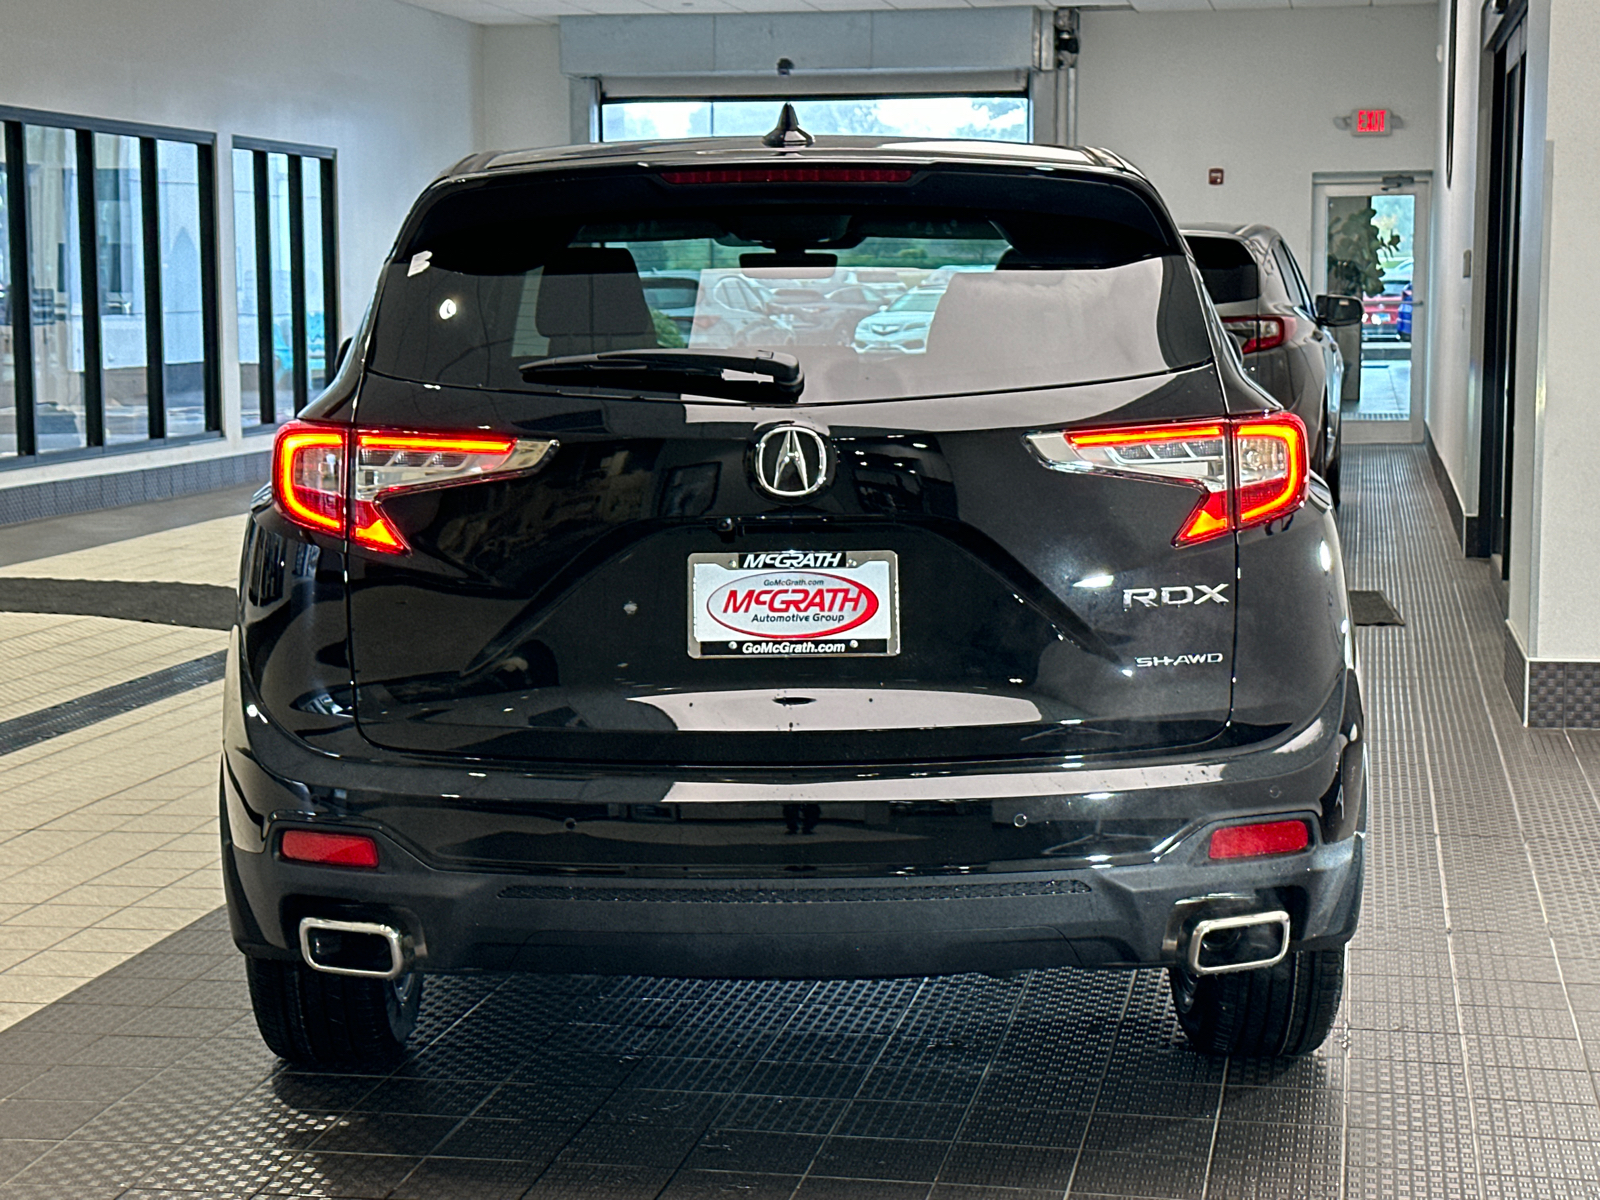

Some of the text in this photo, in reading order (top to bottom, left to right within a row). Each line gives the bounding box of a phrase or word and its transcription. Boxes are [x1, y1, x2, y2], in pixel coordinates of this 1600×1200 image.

[1357, 109, 1387, 132] EXIT
[763, 578, 824, 587] GoMcGrath.com
[1123, 583, 1229, 608] RDX
[751, 613, 845, 623] Automotive Group
[742, 641, 846, 654] GoMcGrath.com
